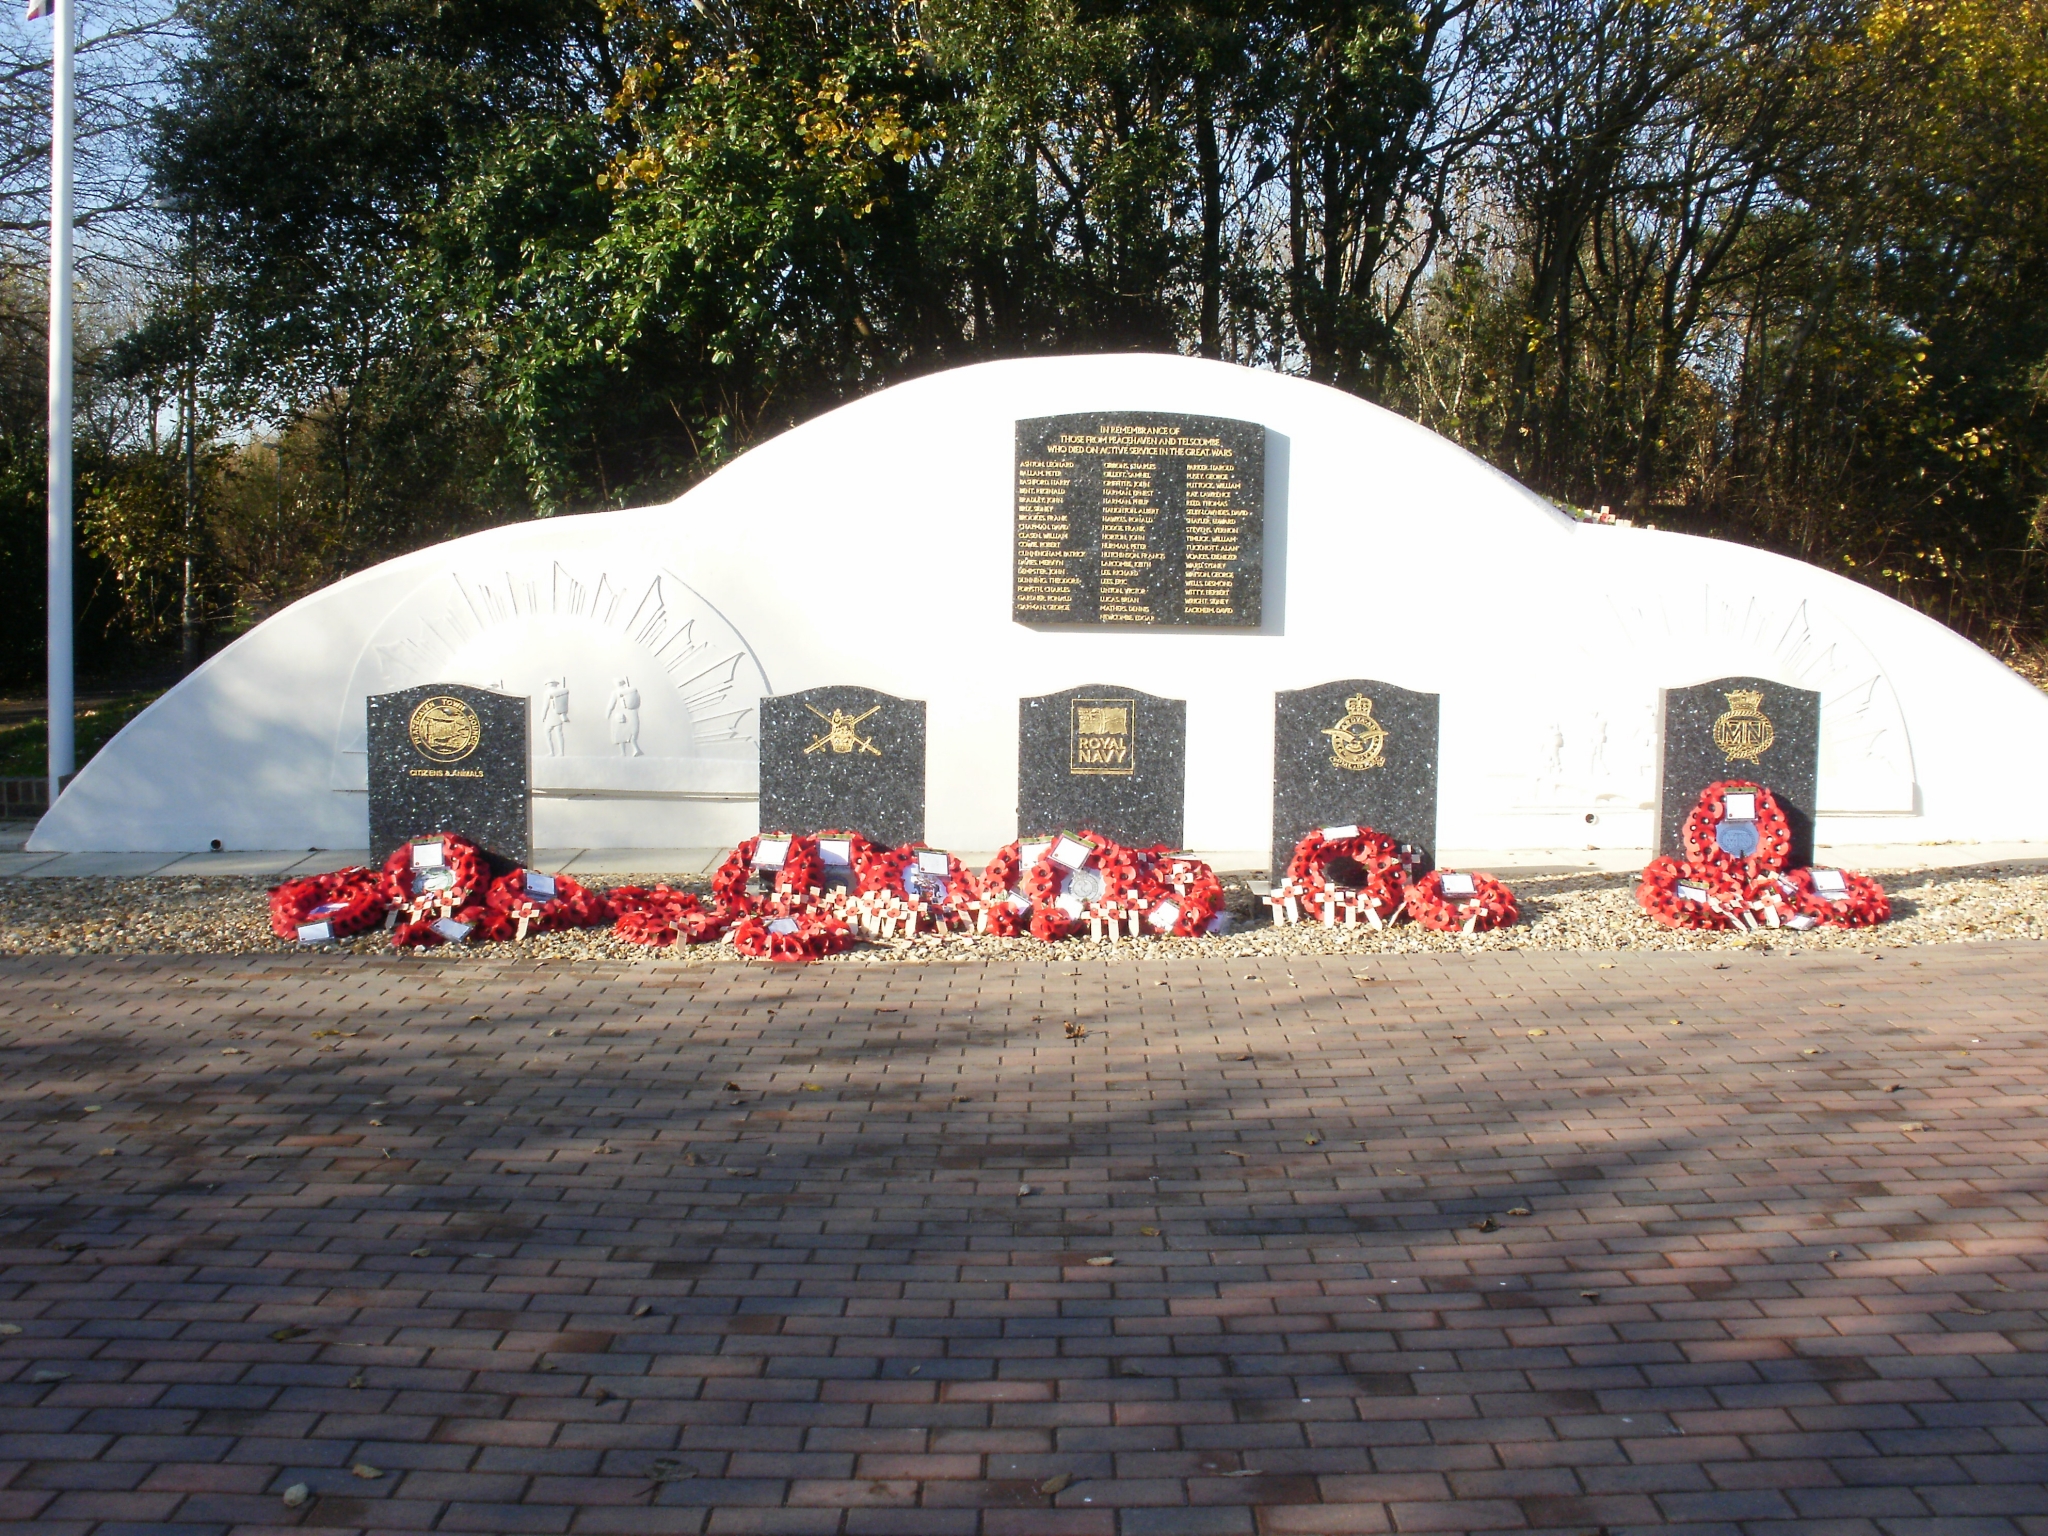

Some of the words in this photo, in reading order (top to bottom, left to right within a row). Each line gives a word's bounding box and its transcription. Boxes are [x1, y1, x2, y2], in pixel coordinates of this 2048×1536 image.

[1111, 426, 1168, 434] REMEMBRANCE
[1061, 436, 1084, 444] THOSE
[1108, 436, 1157, 444] PEACEHAVEN
[1178, 438, 1220, 446] TELSCOMBE
[1100, 446, 1128, 454] ACTIVE
[441, 699, 466, 711] TOWN
[1079, 737, 1126, 749] ROYAL
[1079, 749, 1126, 763] NAVY
